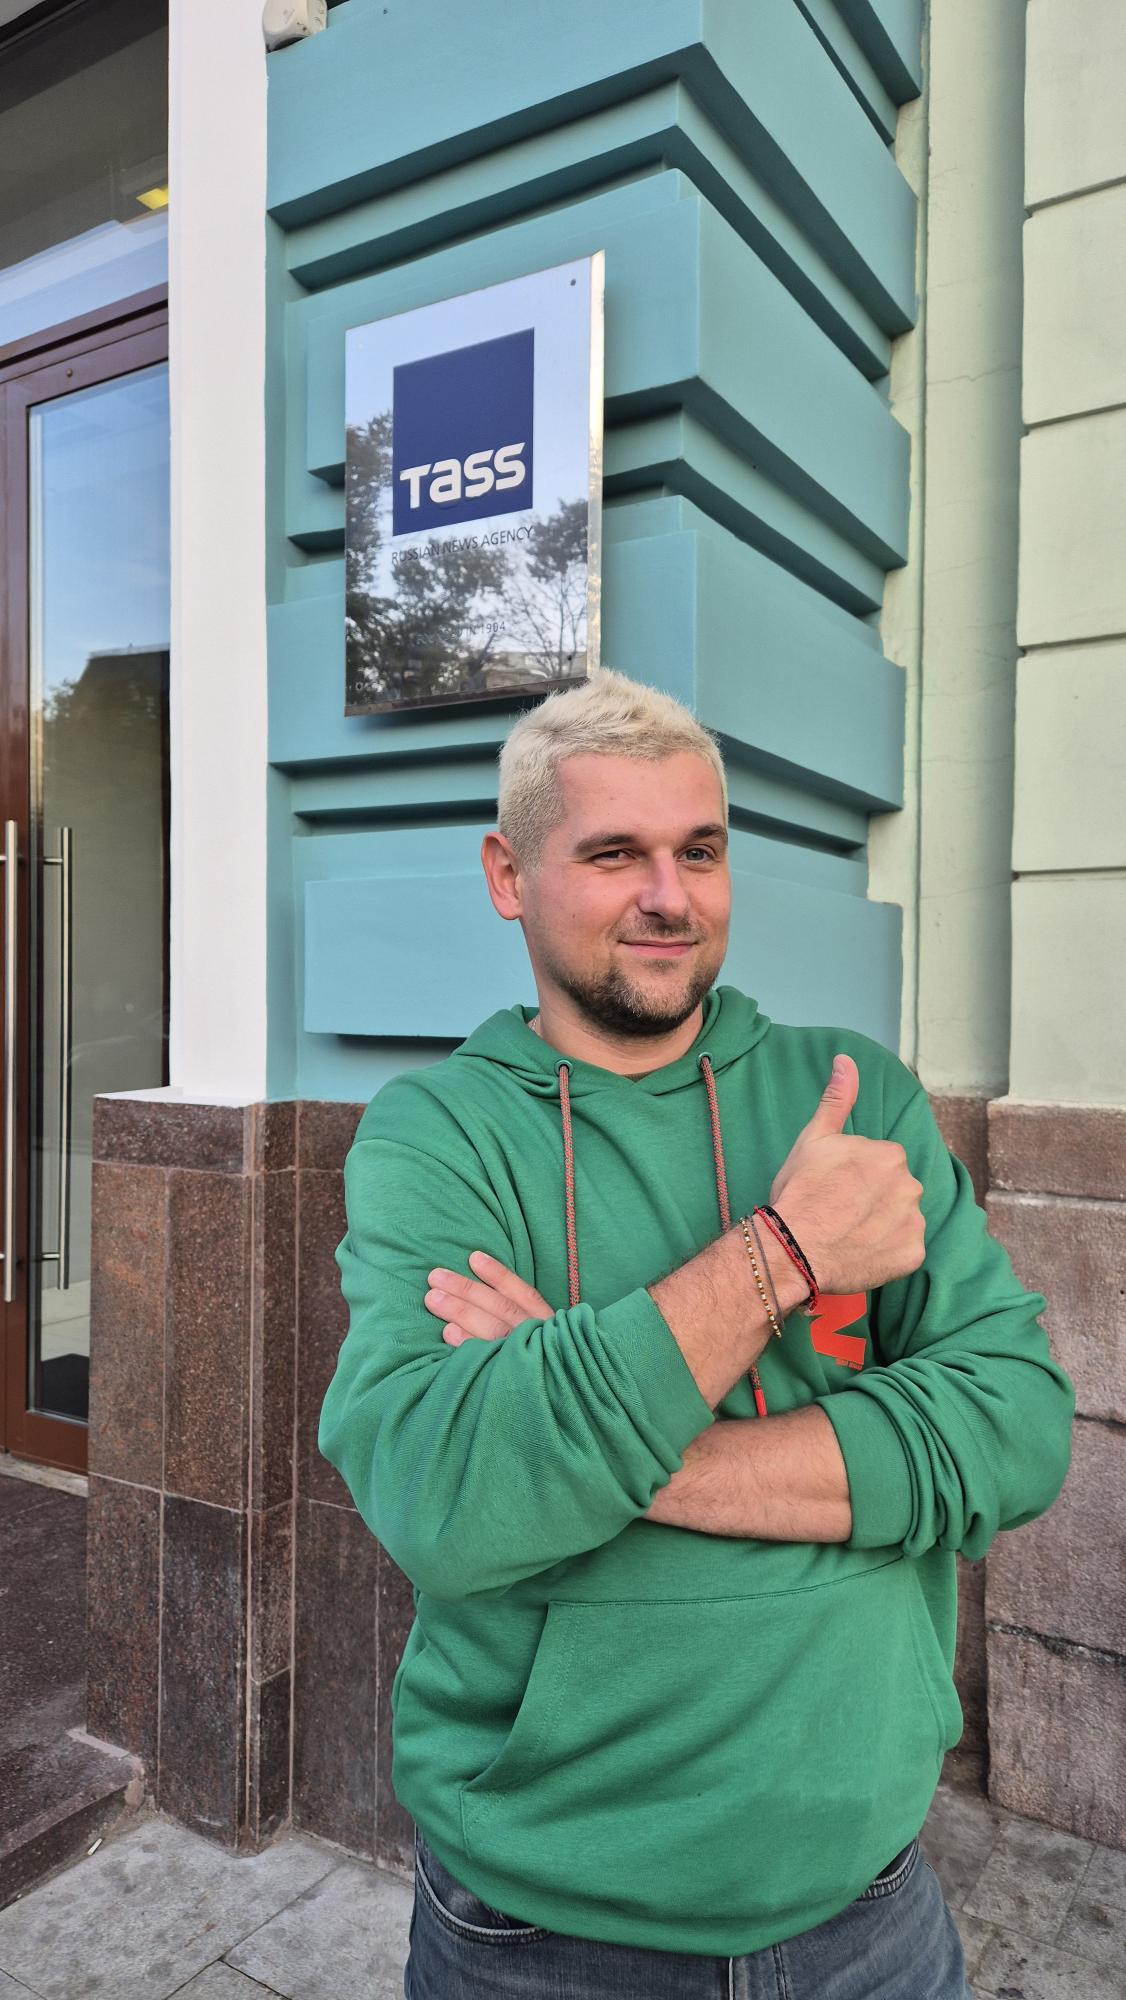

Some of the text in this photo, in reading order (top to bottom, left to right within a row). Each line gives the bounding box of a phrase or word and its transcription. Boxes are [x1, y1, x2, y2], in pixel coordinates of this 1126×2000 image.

[391, 526, 534, 566] RUSSIAN NEWS AGENCY
[480, 621, 506, 634] 1904
